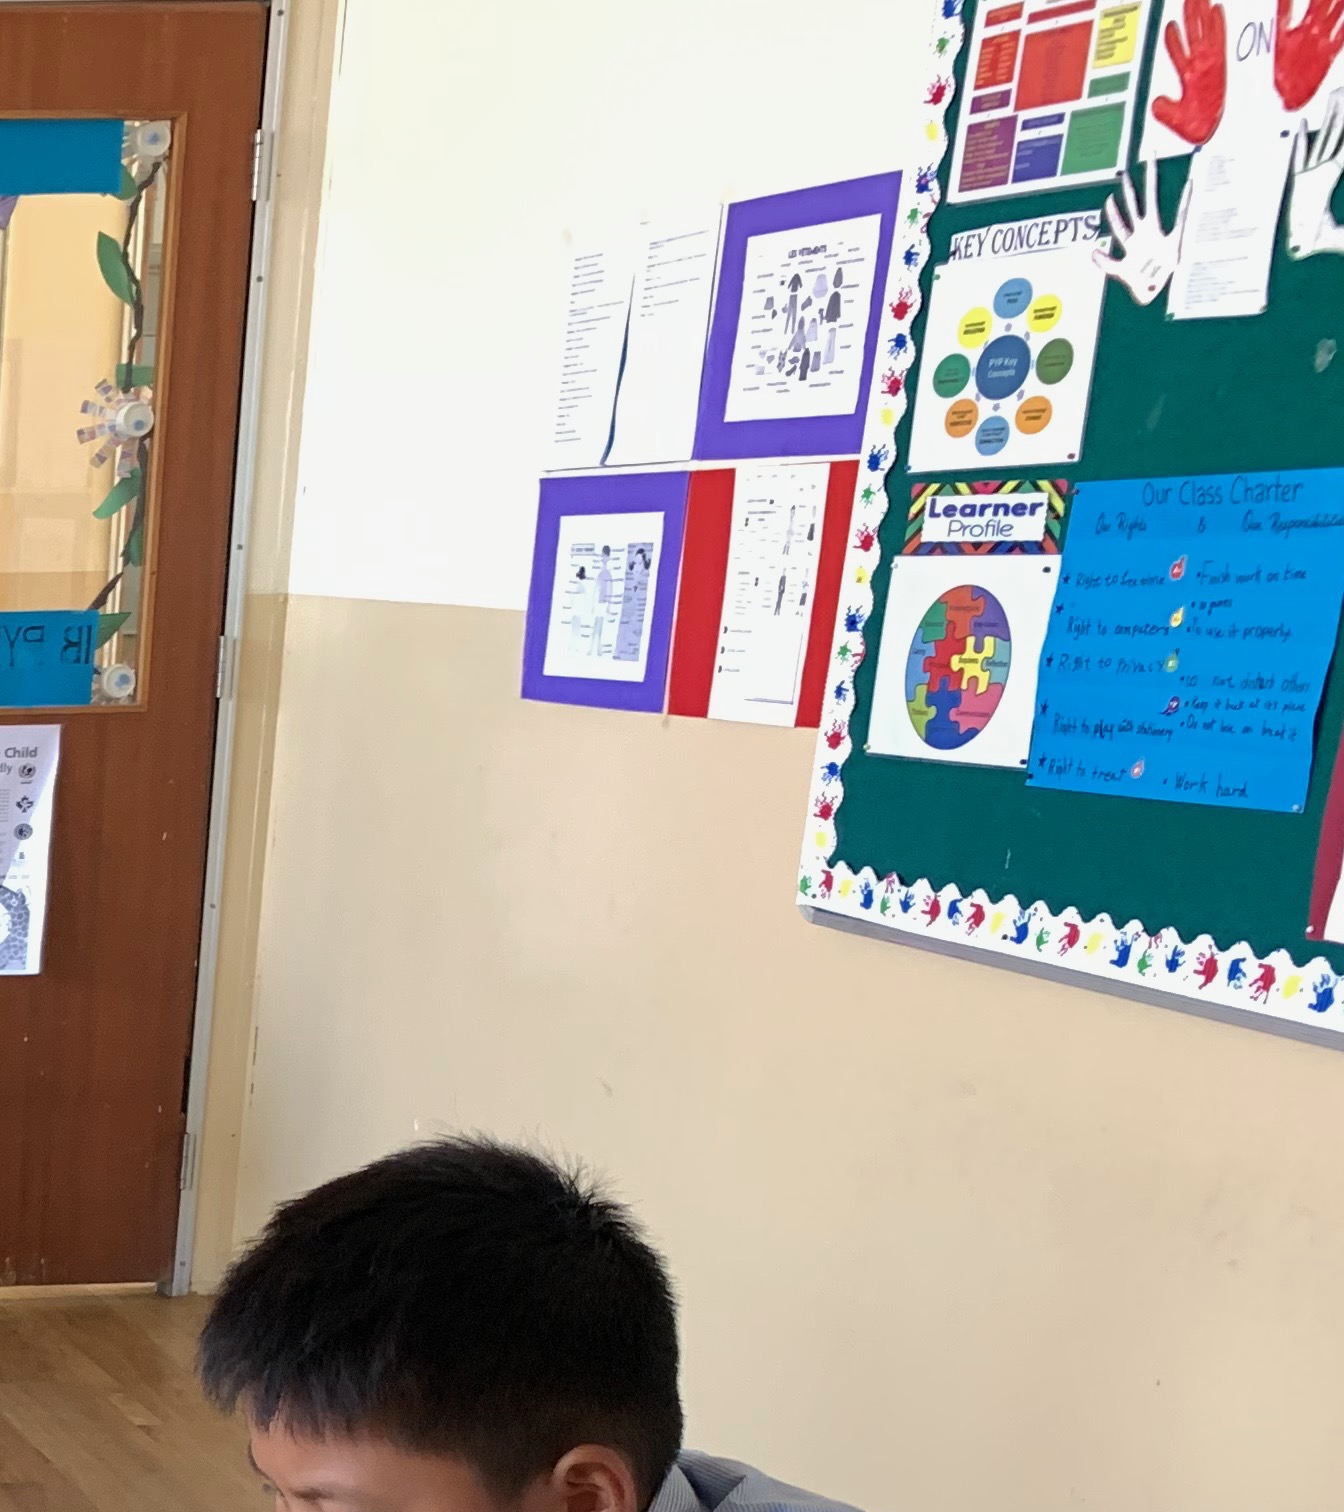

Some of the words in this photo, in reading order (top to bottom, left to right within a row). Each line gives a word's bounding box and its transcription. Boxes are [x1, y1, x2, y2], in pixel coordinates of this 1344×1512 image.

[952, 227, 991, 260] KEY
[991, 214, 1101, 255] CONCEPTS
[1142, 481, 1172, 506] Our
[1178, 480, 1224, 505] Class
[1230, 474, 1304, 504] Charter
[928, 498, 1044, 518] Learner
[947, 519, 1014, 537] Profile
[1116, 511, 1147, 540] Rights
[1105, 573, 1118, 586] to
[1066, 616, 1091, 640] Right
[1098, 620, 1107, 636] to
[1058, 653, 1090, 673] Right
[1099, 657, 1112, 669] to
[1053, 712, 1077, 735] Right
[1081, 719, 1090, 734] to
[1093, 719, 1114, 741] play
[4, 747, 38, 759] Child
[1047, 756, 1073, 780] Right
[1077, 760, 1086, 776] to
[1175, 771, 1208, 794] Work
[1215, 772, 1248, 798] hard
